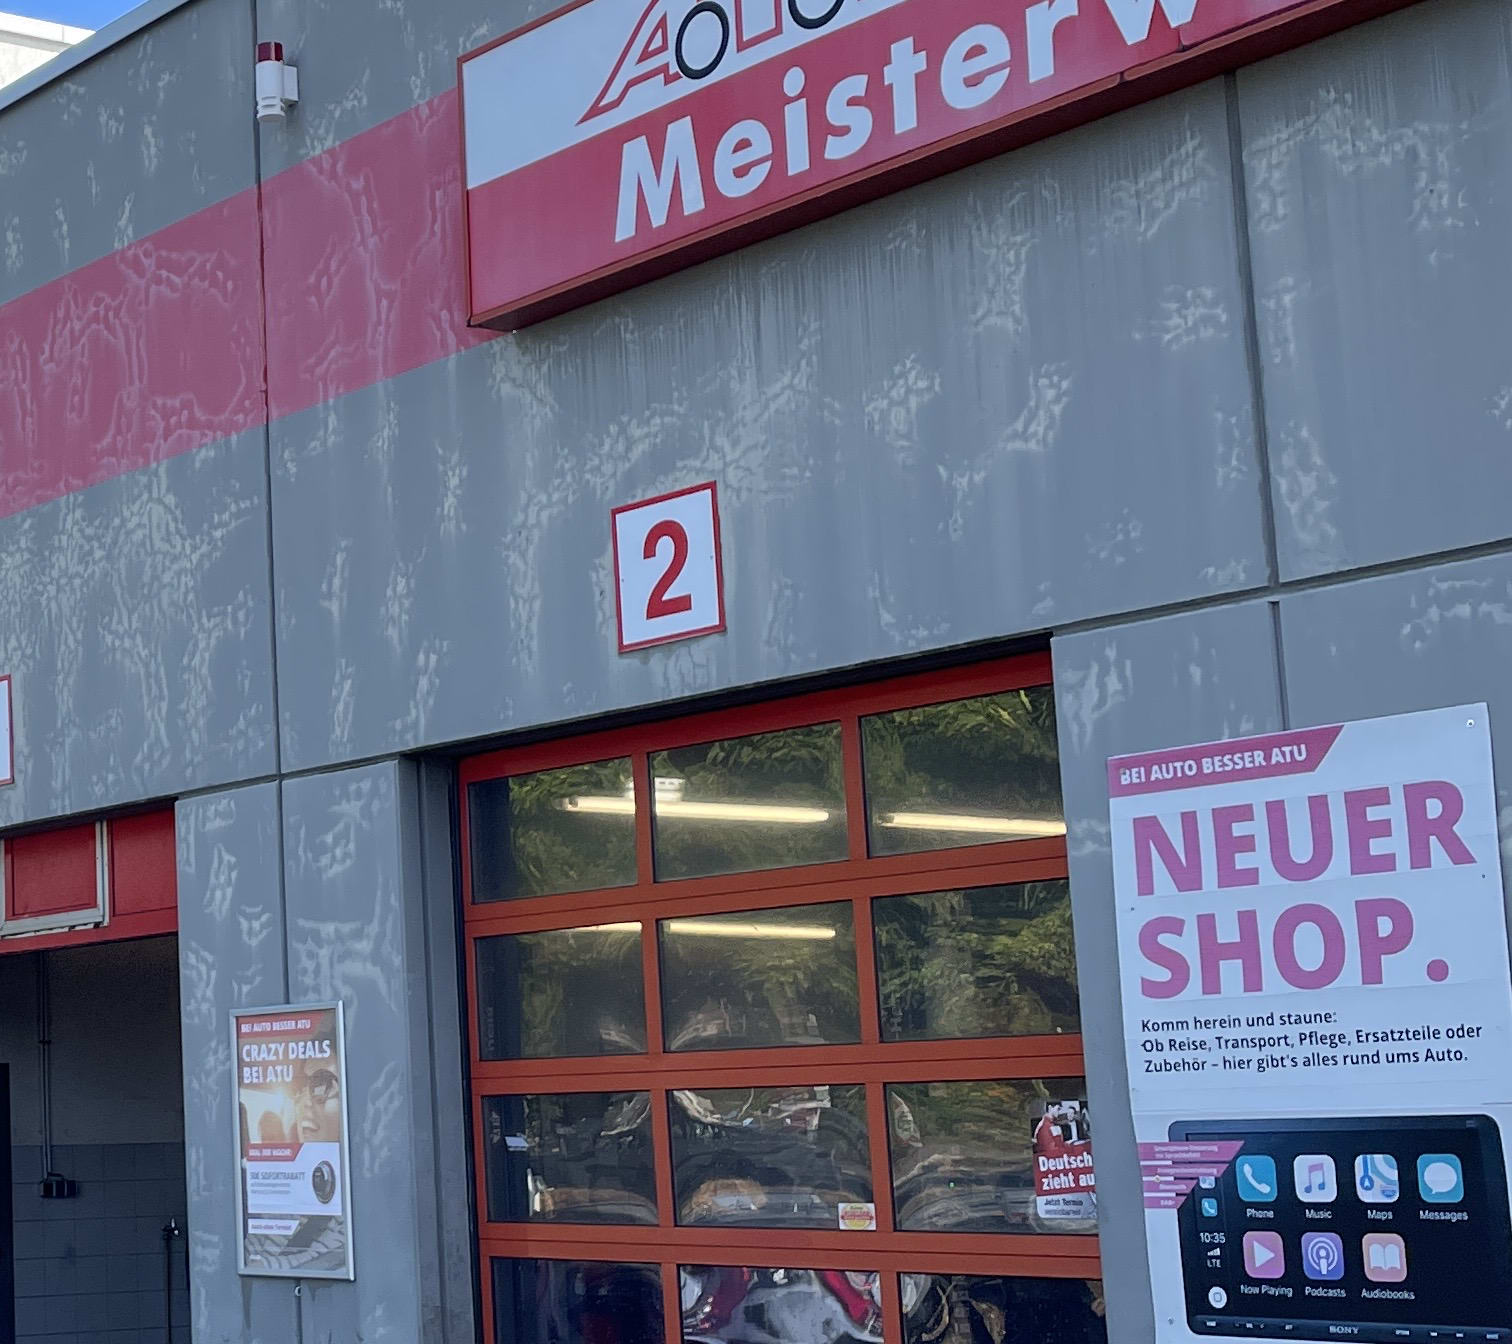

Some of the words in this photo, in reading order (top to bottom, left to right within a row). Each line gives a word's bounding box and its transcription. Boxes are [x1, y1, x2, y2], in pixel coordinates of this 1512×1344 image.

[642, 519, 693, 621] 2
[1120, 767, 1146, 785] BEI
[1150, 760, 1197, 781] AUTO
[1202, 750, 1266, 774] BESSER
[1271, 744, 1307, 764] ATU
[1132, 780, 1477, 896] NEUER
[1138, 897, 1449, 999] SHOP.
[253, 1022, 271, 1032] AUTO
[272, 1020, 296, 1031] BESSER
[297, 1019, 311, 1029] ATU
[1141, 1019, 1189, 1032] Komm
[1193, 1015, 1241, 1030] herein
[1246, 1012, 1275, 1027] und
[1279, 1011, 1337, 1026] staune:
[1142, 1039, 1164, 1052] Ob
[1169, 1037, 1212, 1052] Reise,
[1215, 1034, 1294, 1052] Transport,
[1299, 1031, 1351, 1048] Pflege,
[1356, 1025, 1441, 1044] Ersatzteile
[1446, 1024, 1482, 1039] oder
[242, 1042, 285, 1062] CRAZY
[288, 1040, 331, 1060] DEALS
[1144, 1058, 1207, 1073] Zubehör
[1223, 1056, 1252, 1069] hier
[1257, 1054, 1298, 1073] gibt's
[1302, 1052, 1338, 1067] alles
[1343, 1049, 1380, 1065] rund
[1386, 1052, 1419, 1064] ums
[1424, 1048, 1468, 1062] Auto.
[243, 1066, 264, 1083] BEI
[267, 1064, 293, 1083] ATU
[1038, 1151, 1093, 1172] Deutsch
[1041, 1172, 1076, 1191] zieht
[1246, 1208, 1274, 1218] Phone
[1305, 1208, 1332, 1219] Music
[1367, 1209, 1393, 1220] Maps
[1419, 1209, 1469, 1222] Messages
[1199, 1232, 1226, 1243] 10:35
[1207, 1258, 1221, 1268] LTE
[1240, 1284, 1259, 1294] Now
[1261, 1284, 1293, 1297] Playing
[1305, 1286, 1347, 1297] Podcasts
[1361, 1287, 1416, 1300] Audiobooks
[1329, 1325, 1359, 1334] SONY
